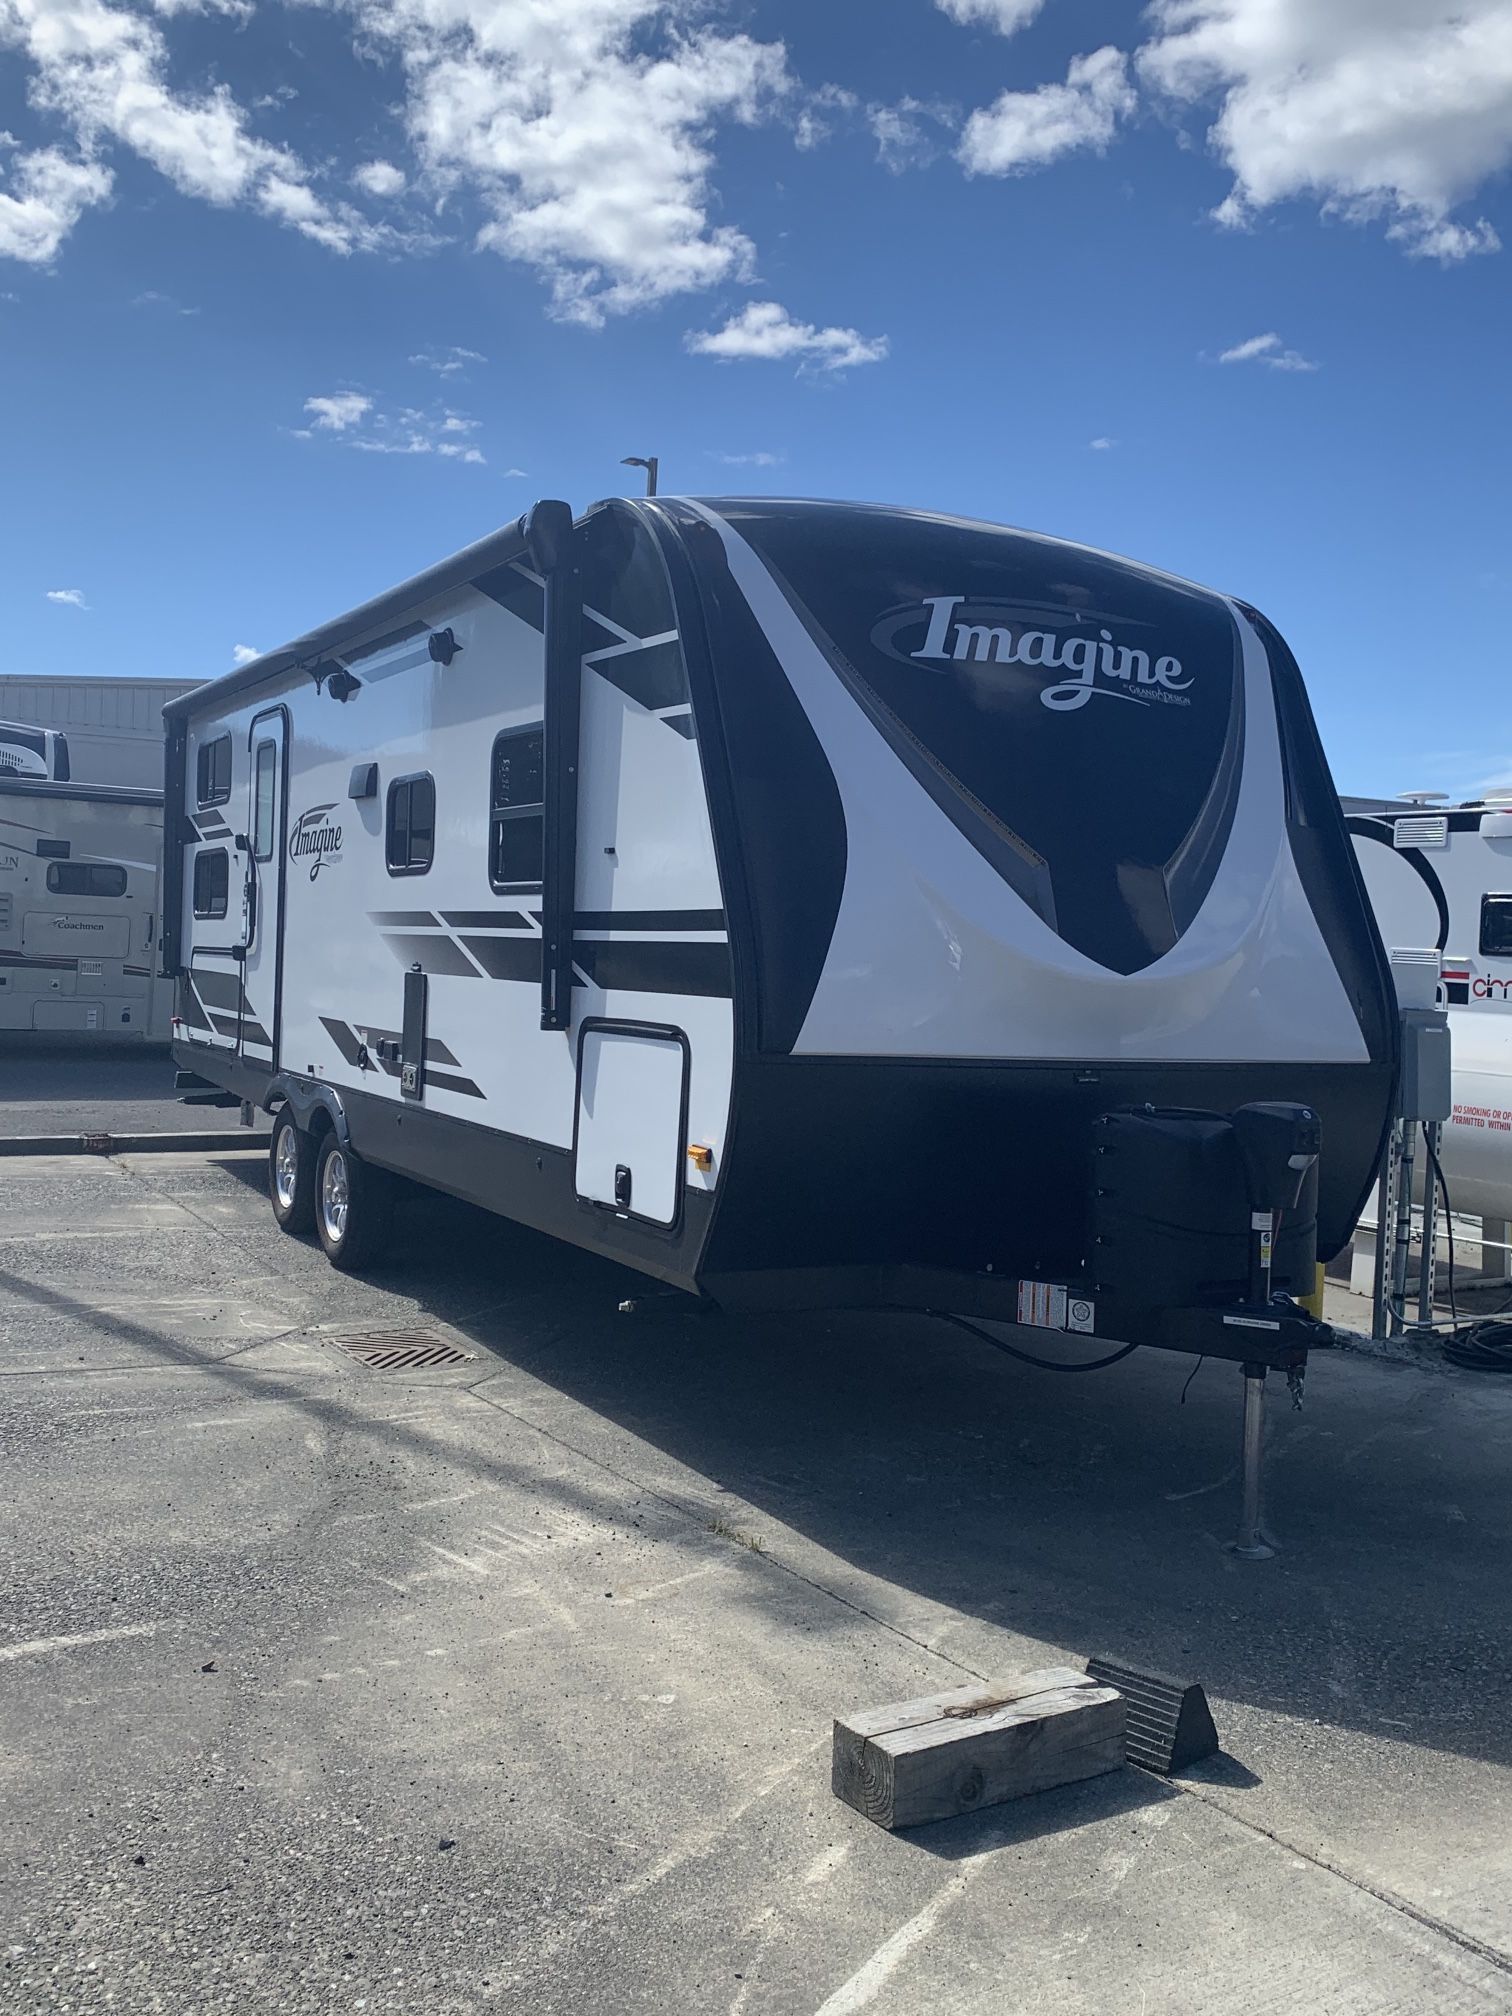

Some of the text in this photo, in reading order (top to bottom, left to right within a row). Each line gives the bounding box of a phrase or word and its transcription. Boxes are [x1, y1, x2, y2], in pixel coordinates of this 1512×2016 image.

[911, 595, 1196, 712] Imagine
[293, 813, 343, 882] Imagine
[57, 922, 104, 931] Coachmen
[1453, 1104, 1463, 1114] NO
[1463, 1105, 1491, 1118] SMOKING
[1492, 1109, 1502, 1119] OR
[1452, 1115, 1511, 1131] PERMITTED WITHIN
